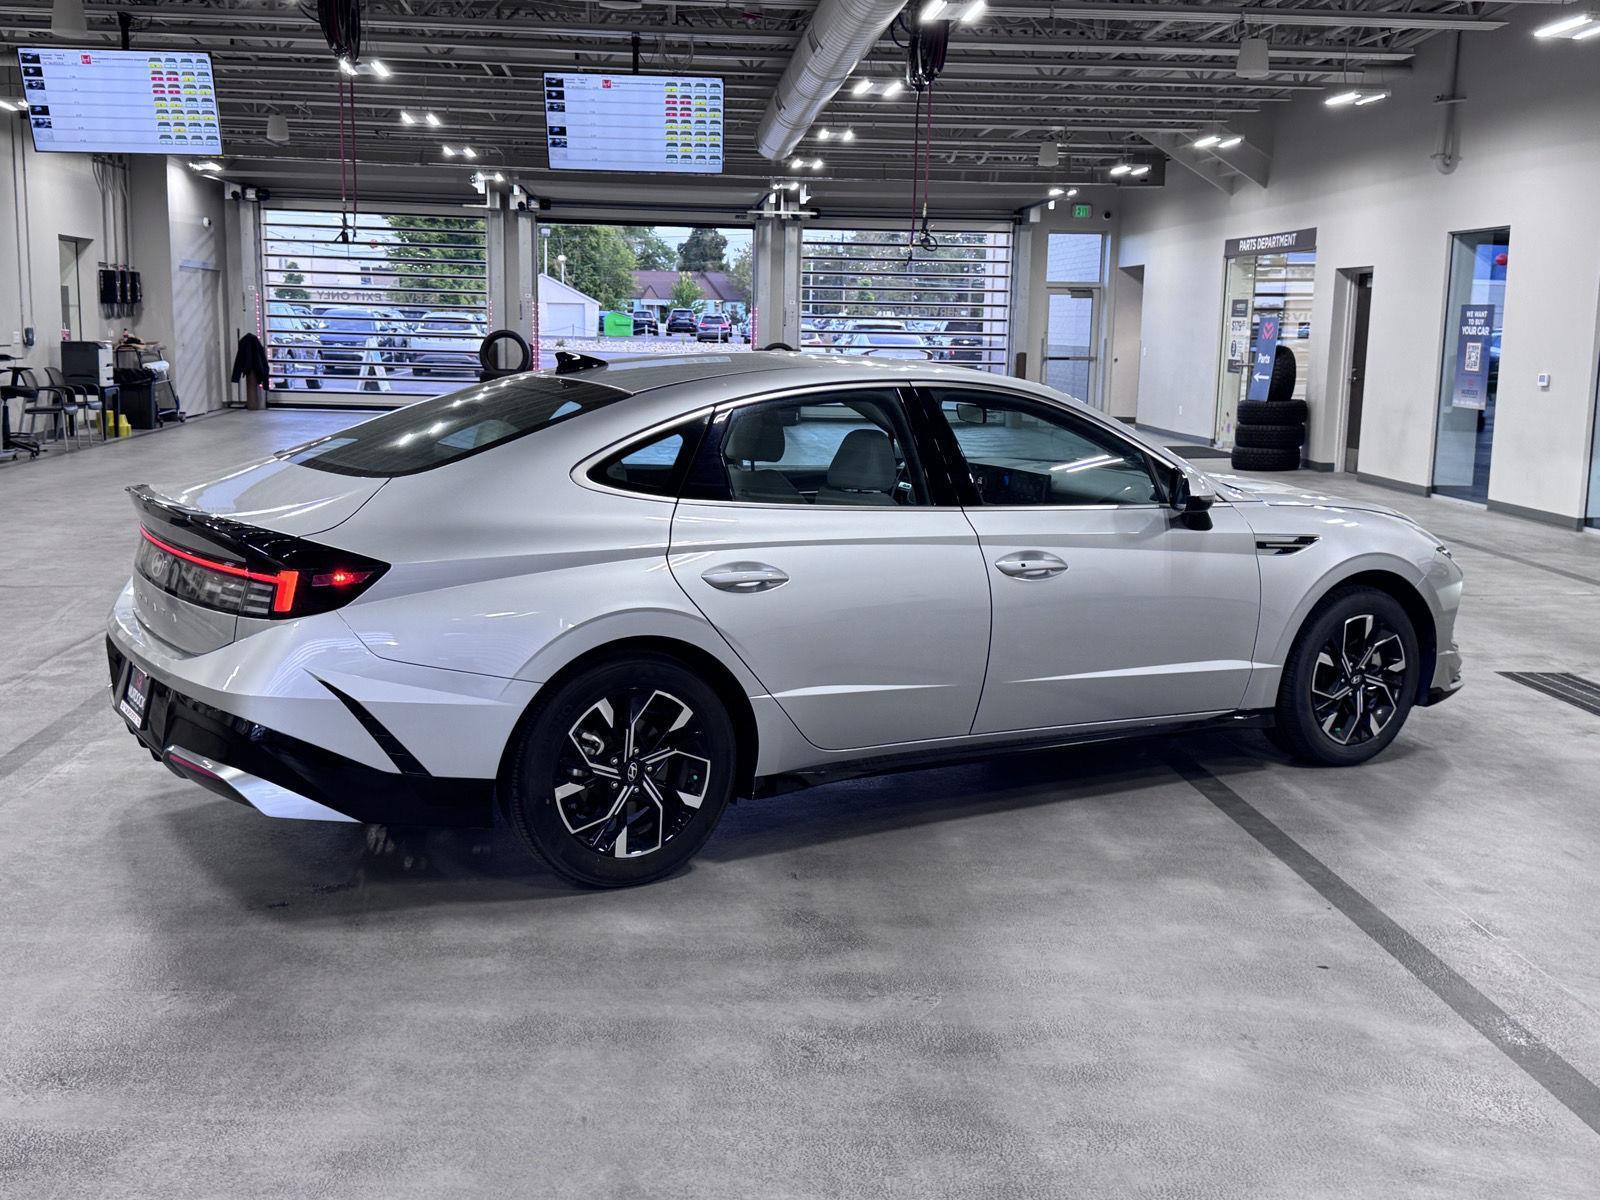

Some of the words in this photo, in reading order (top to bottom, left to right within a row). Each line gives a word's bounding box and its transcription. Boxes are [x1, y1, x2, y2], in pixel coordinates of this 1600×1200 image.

[1239, 238, 1257, 251] PARTS
[1257, 232, 1297, 250] DEPARTMENT
[1466, 310, 1474, 318] WE
[1474, 310, 1488, 318] WANT
[1462, 326, 1477, 336] YOUR
[1477, 326, 1490, 336] CAR
[1257, 352, 1271, 364] Parts
